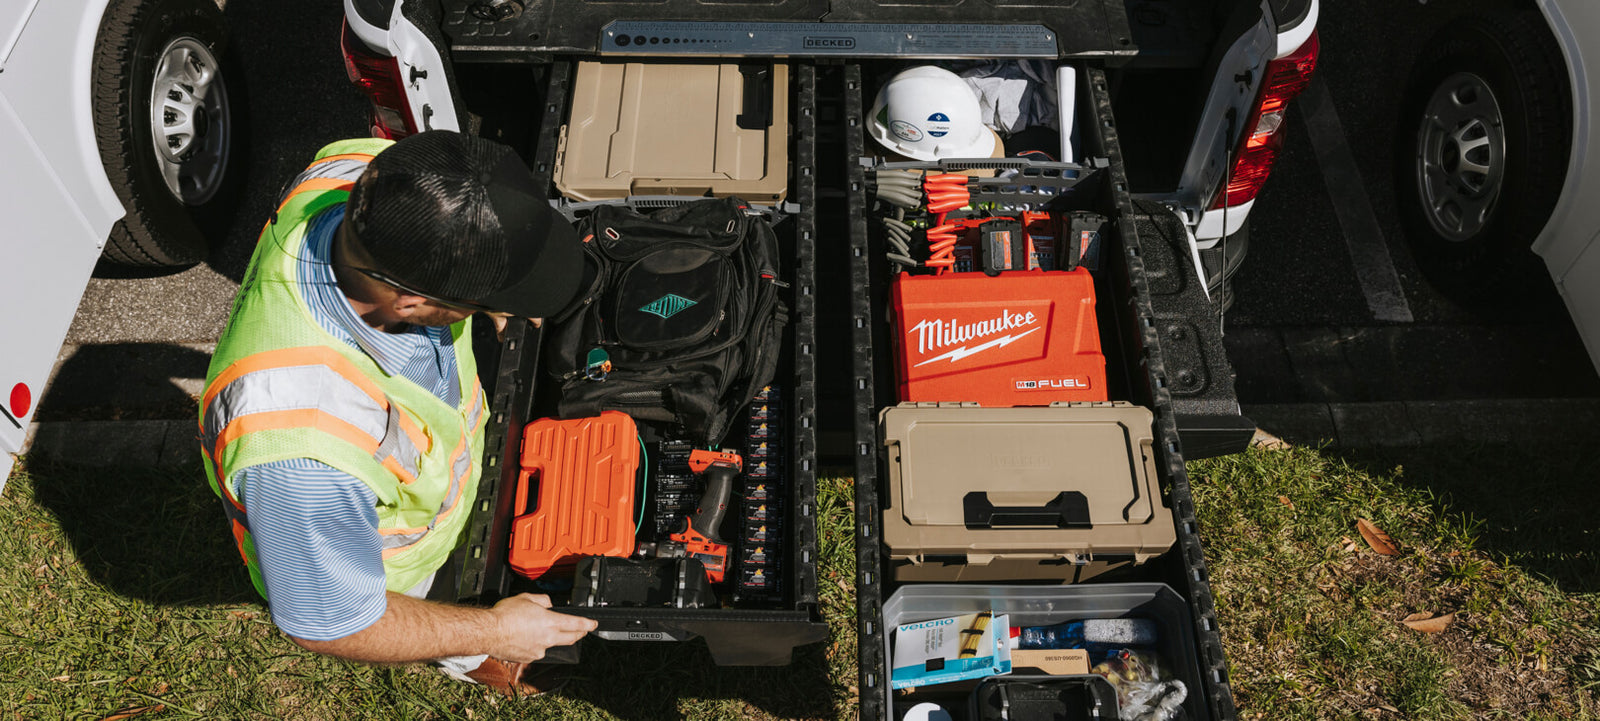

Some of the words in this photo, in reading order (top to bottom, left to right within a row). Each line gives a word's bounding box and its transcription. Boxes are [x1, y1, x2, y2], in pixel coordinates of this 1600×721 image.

[806, 39, 853, 47] DECKED
[908, 309, 1037, 354] Milwaukee
[1016, 381, 1036, 389] M18
[1038, 379, 1086, 388] FUEL
[630, 632, 661, 640] DECKED
